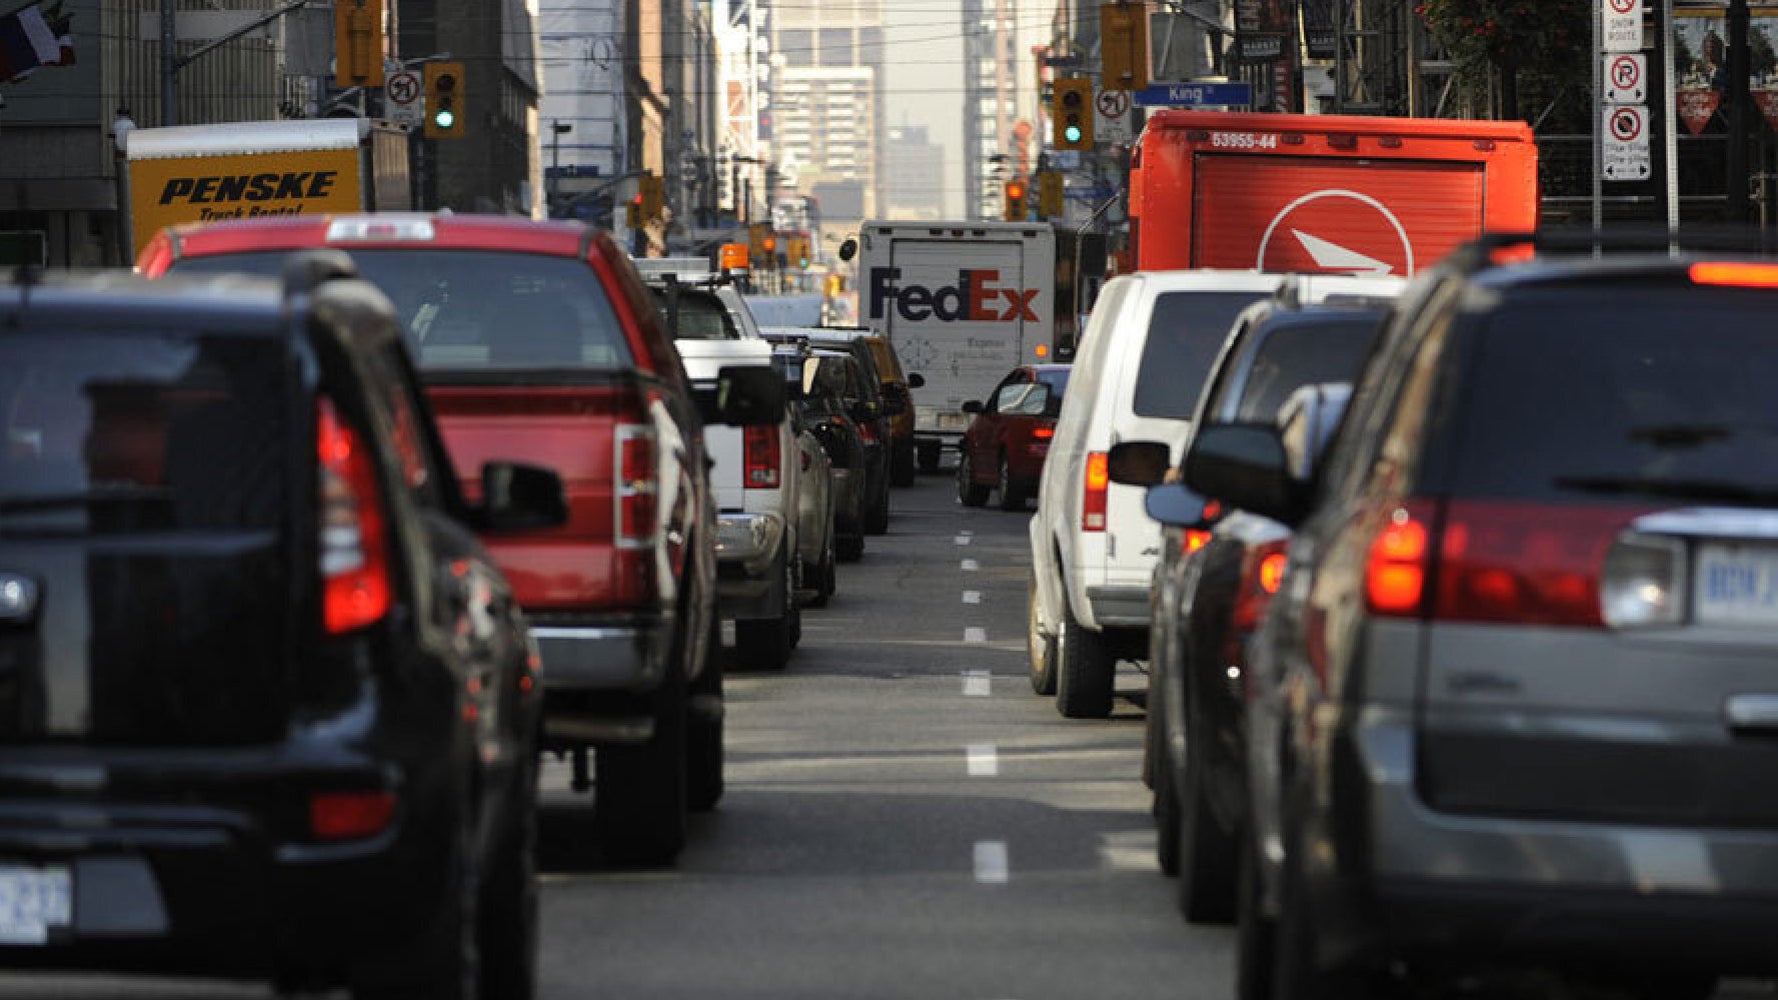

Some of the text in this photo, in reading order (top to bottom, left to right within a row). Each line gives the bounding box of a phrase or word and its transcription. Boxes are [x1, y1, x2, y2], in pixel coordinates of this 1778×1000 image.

[1169, 85, 1202, 104] King
[1212, 131, 1277, 149] 53955-44
[159, 171, 338, 204] PENSKE
[200, 207, 243, 221] Truck
[870, 268, 1040, 322] FedEx
